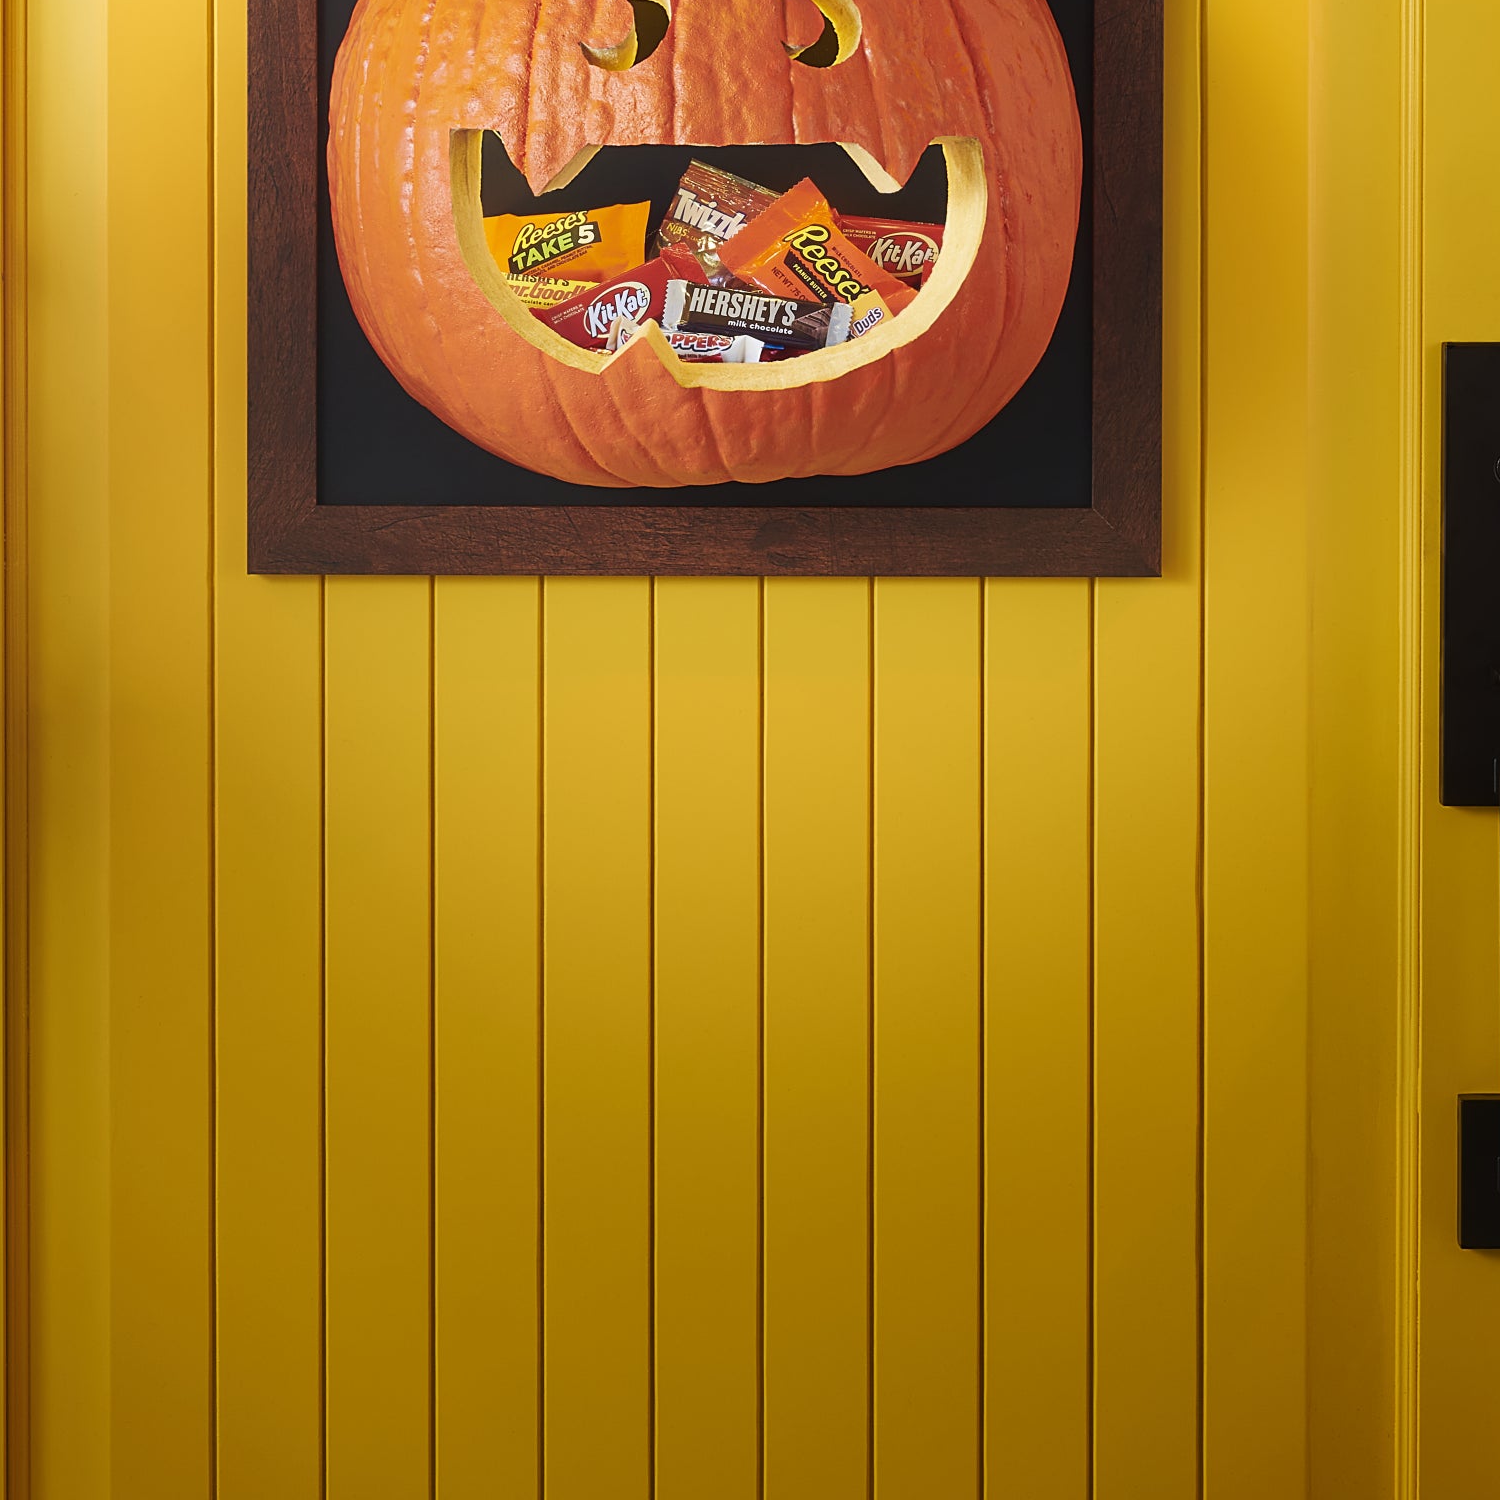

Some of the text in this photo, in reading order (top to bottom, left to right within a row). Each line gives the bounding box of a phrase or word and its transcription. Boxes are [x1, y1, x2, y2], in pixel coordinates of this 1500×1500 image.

[513, 210, 588, 255] Reese's
[666, 221, 689, 238] NIBS
[673, 187, 748, 242] Twizzl
[512, 224, 595, 271] TAKE 5
[784, 225, 870, 303] Reese'
[771, 266, 783, 280] NET
[780, 276, 794, 289] WT
[792, 263, 828, 299] PEANUT BUTTER
[689, 287, 798, 327] HERSHEY'S
[853, 307, 883, 335] Duds
[727, 319, 794, 336] milk chocolate
